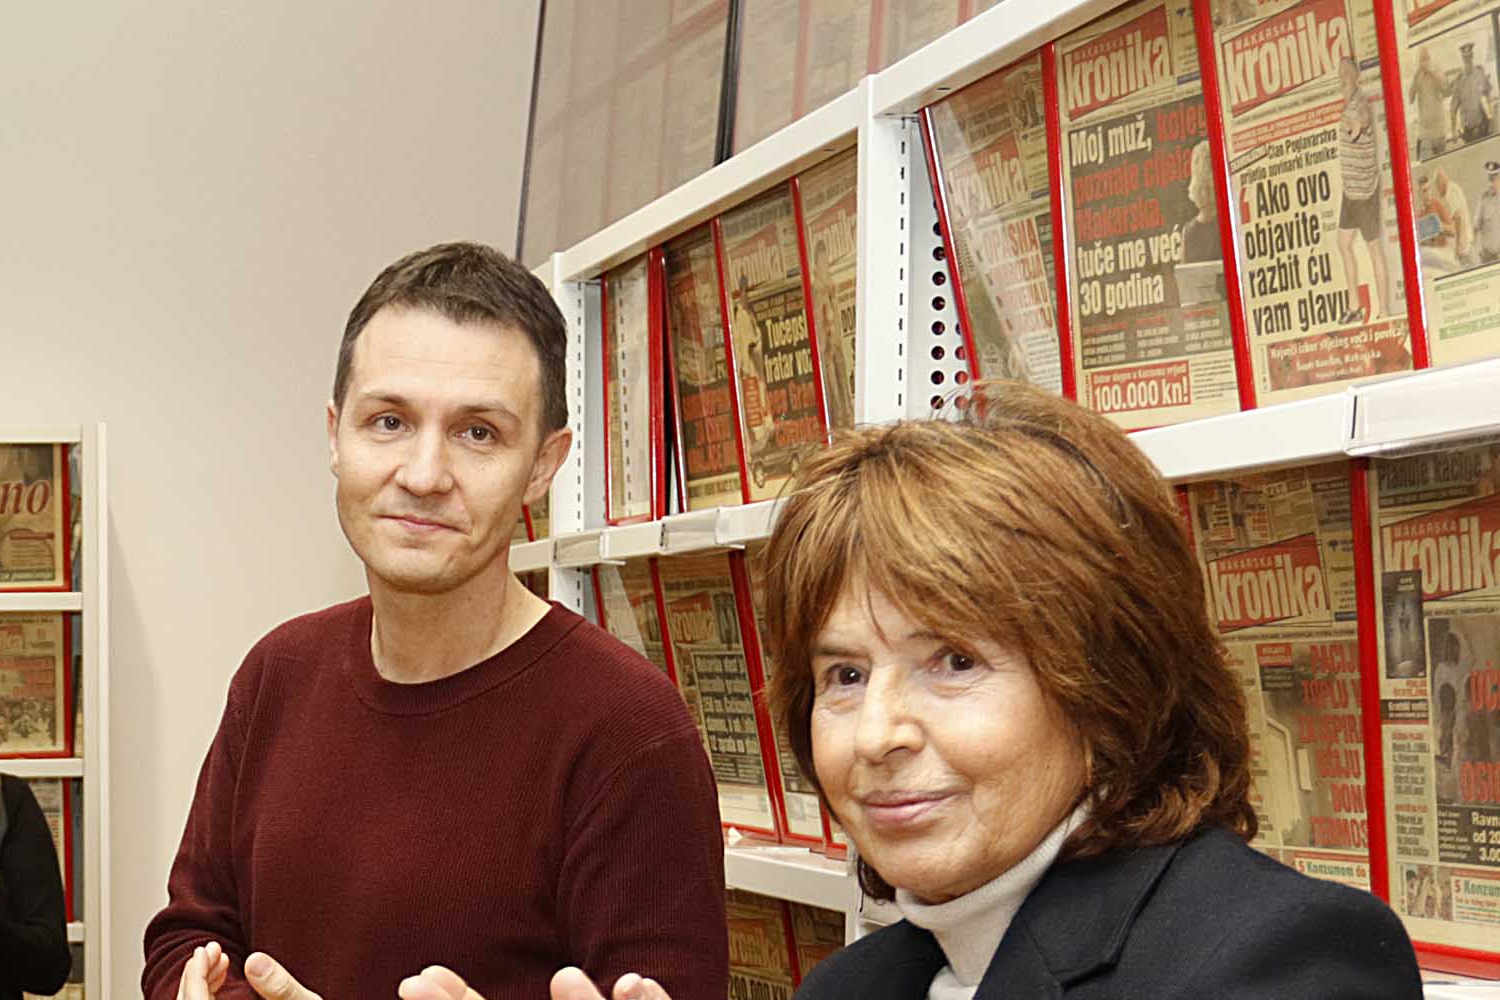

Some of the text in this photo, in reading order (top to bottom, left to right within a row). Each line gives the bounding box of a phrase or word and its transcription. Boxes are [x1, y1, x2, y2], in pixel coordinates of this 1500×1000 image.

[1065, 31, 1173, 108] kronika
[1223, 11, 1349, 105] kronika
[1070, 126, 1104, 167] Moj
[1108, 113, 1153, 151] muž,
[1296, 171, 1331, 207] ovo
[1077, 240, 1115, 278] tuče
[1118, 239, 1147, 271] me
[1149, 224, 1182, 265] već
[1245, 212, 1320, 260] objavite
[1080, 281, 1102, 316] 30
[1105, 273, 1164, 315] godina
[1249, 249, 1332, 298] razbit ću
[1253, 300, 1292, 336] vam
[1094, 380, 1158, 412] 100.000
[1162, 376, 1189, 402] kn!
[1209, 554, 1327, 622] kronika
[1473, 831, 1486, 844] od
